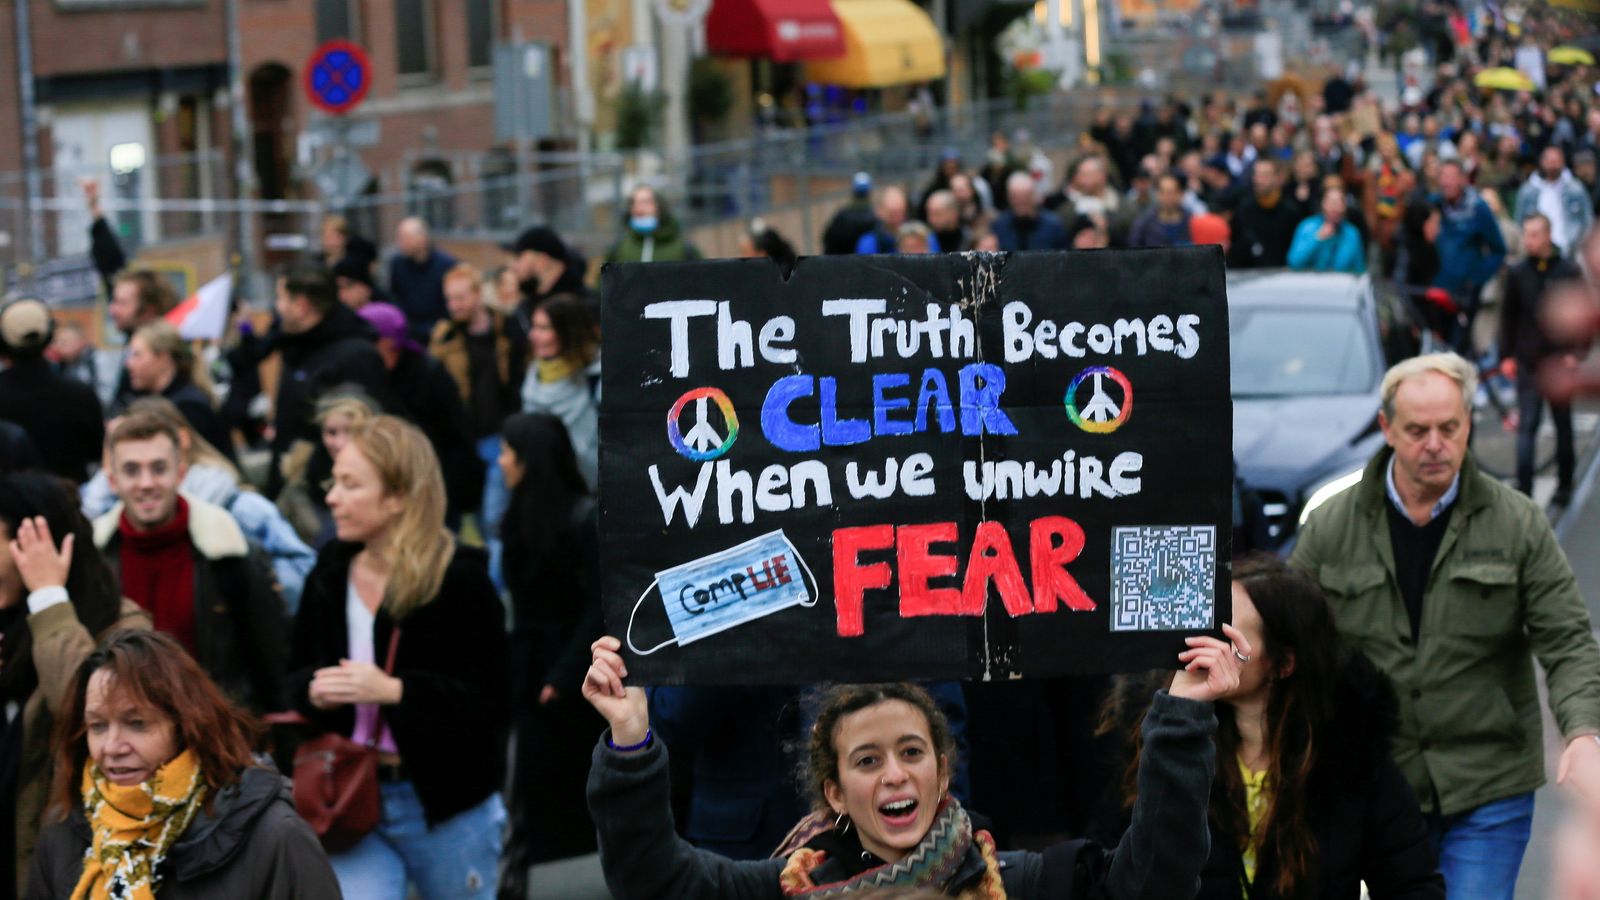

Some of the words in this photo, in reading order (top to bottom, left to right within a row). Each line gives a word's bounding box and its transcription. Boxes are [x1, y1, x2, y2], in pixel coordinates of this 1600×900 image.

[644, 299, 797, 378] The
[822, 298, 975, 363] Truth
[1002, 300, 1201, 364] Becomes
[761, 363, 1019, 452] CLEAR
[648, 458, 833, 529] When
[846, 452, 936, 499] we
[832, 515, 1097, 637] FEAR
